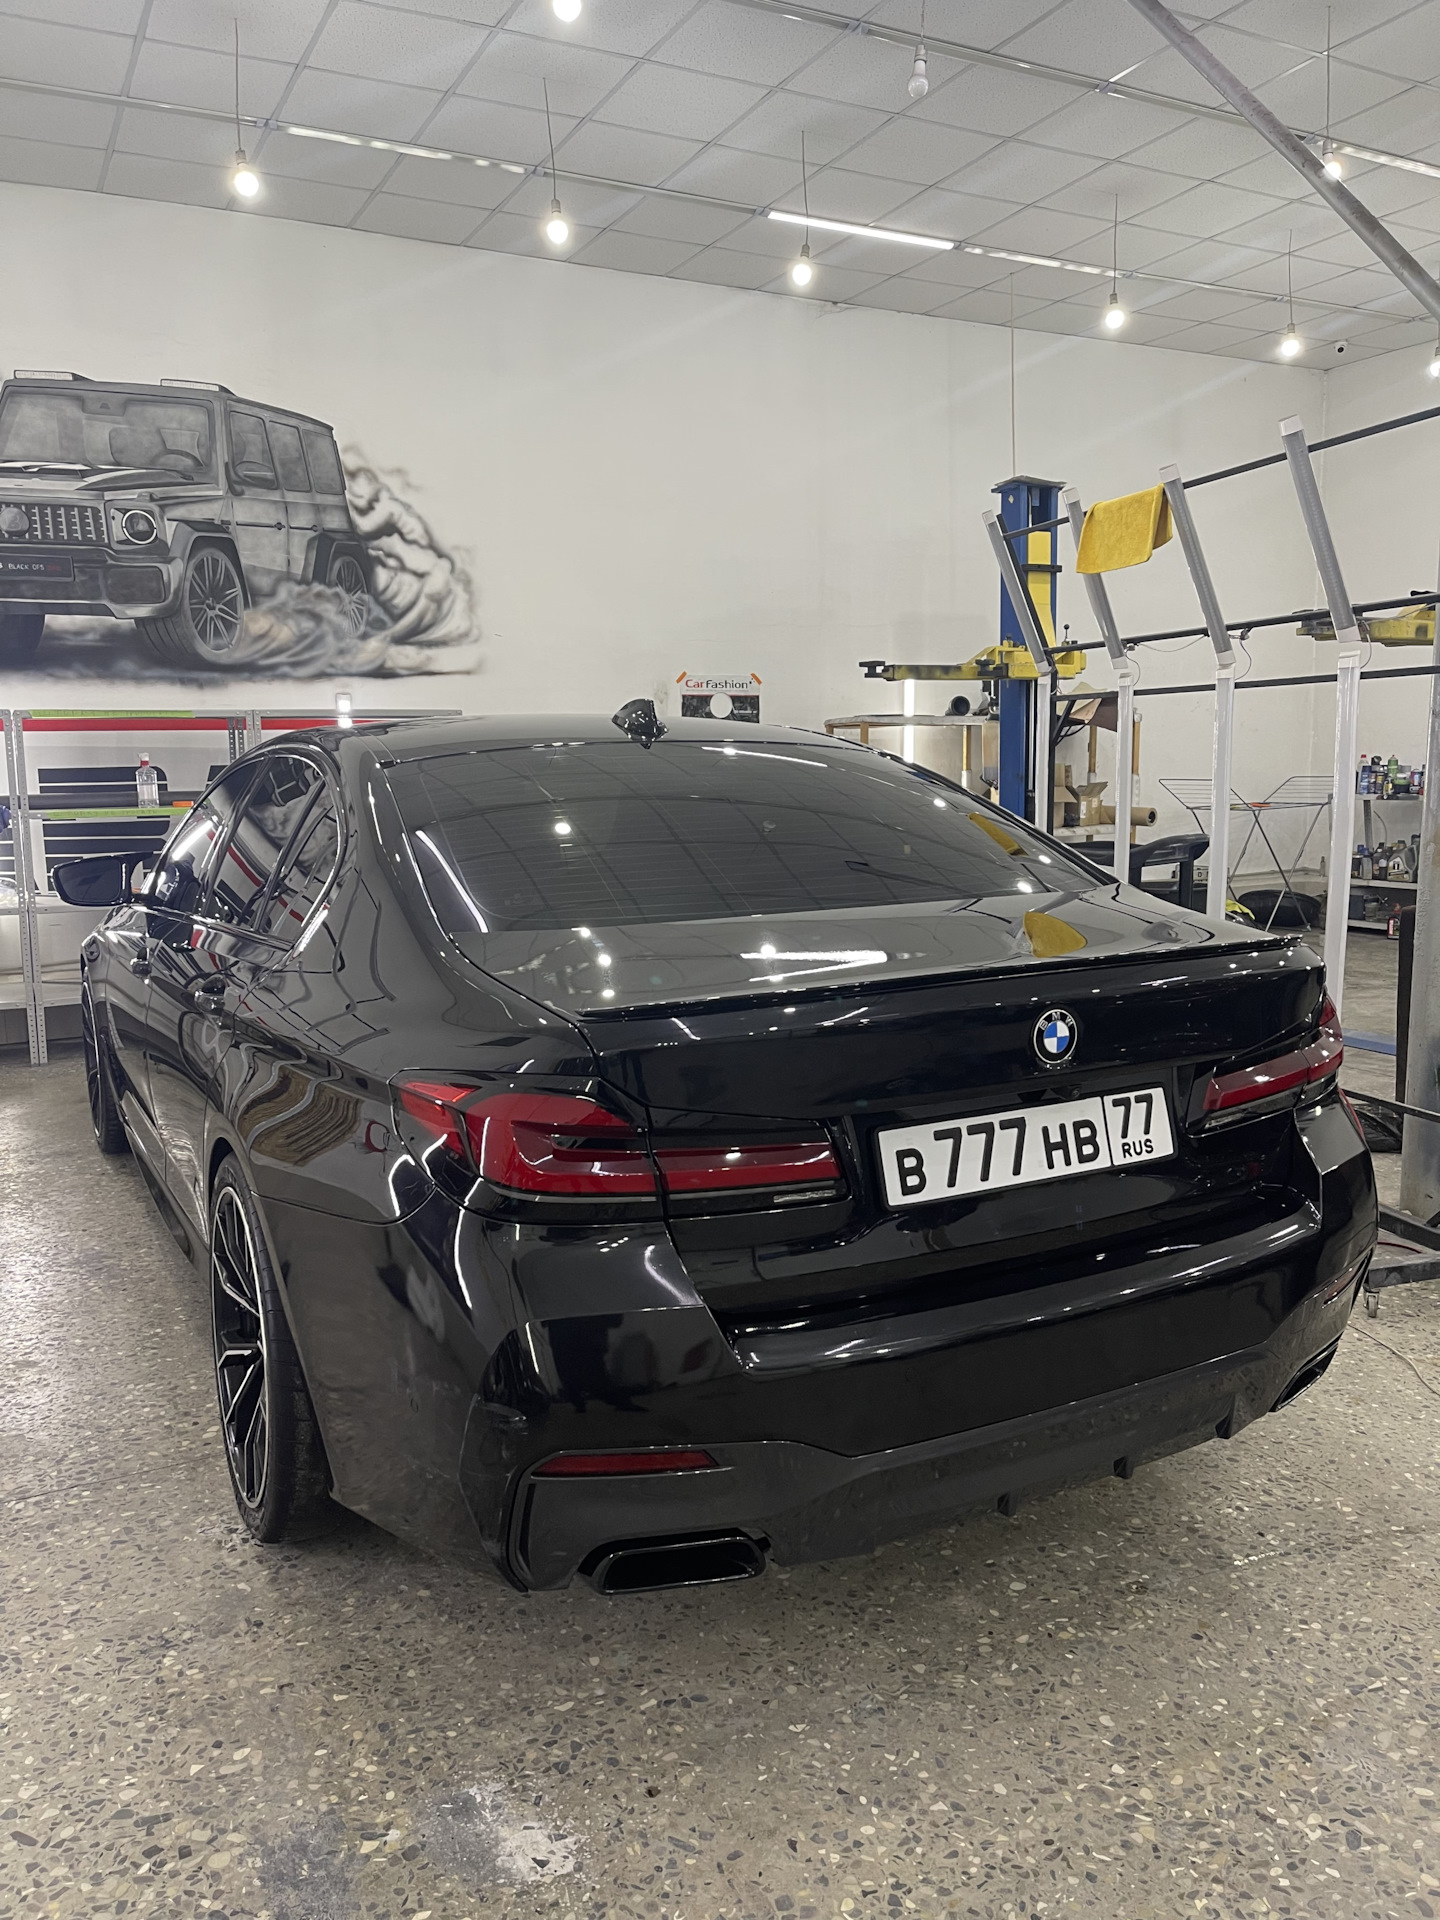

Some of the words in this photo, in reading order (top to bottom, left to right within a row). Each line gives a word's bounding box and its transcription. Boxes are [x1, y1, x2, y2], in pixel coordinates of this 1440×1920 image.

[1039, 1012, 1074, 1031] BMW
[1111, 1092, 1154, 1139] 77
[1121, 1138, 1154, 1159] RUS
